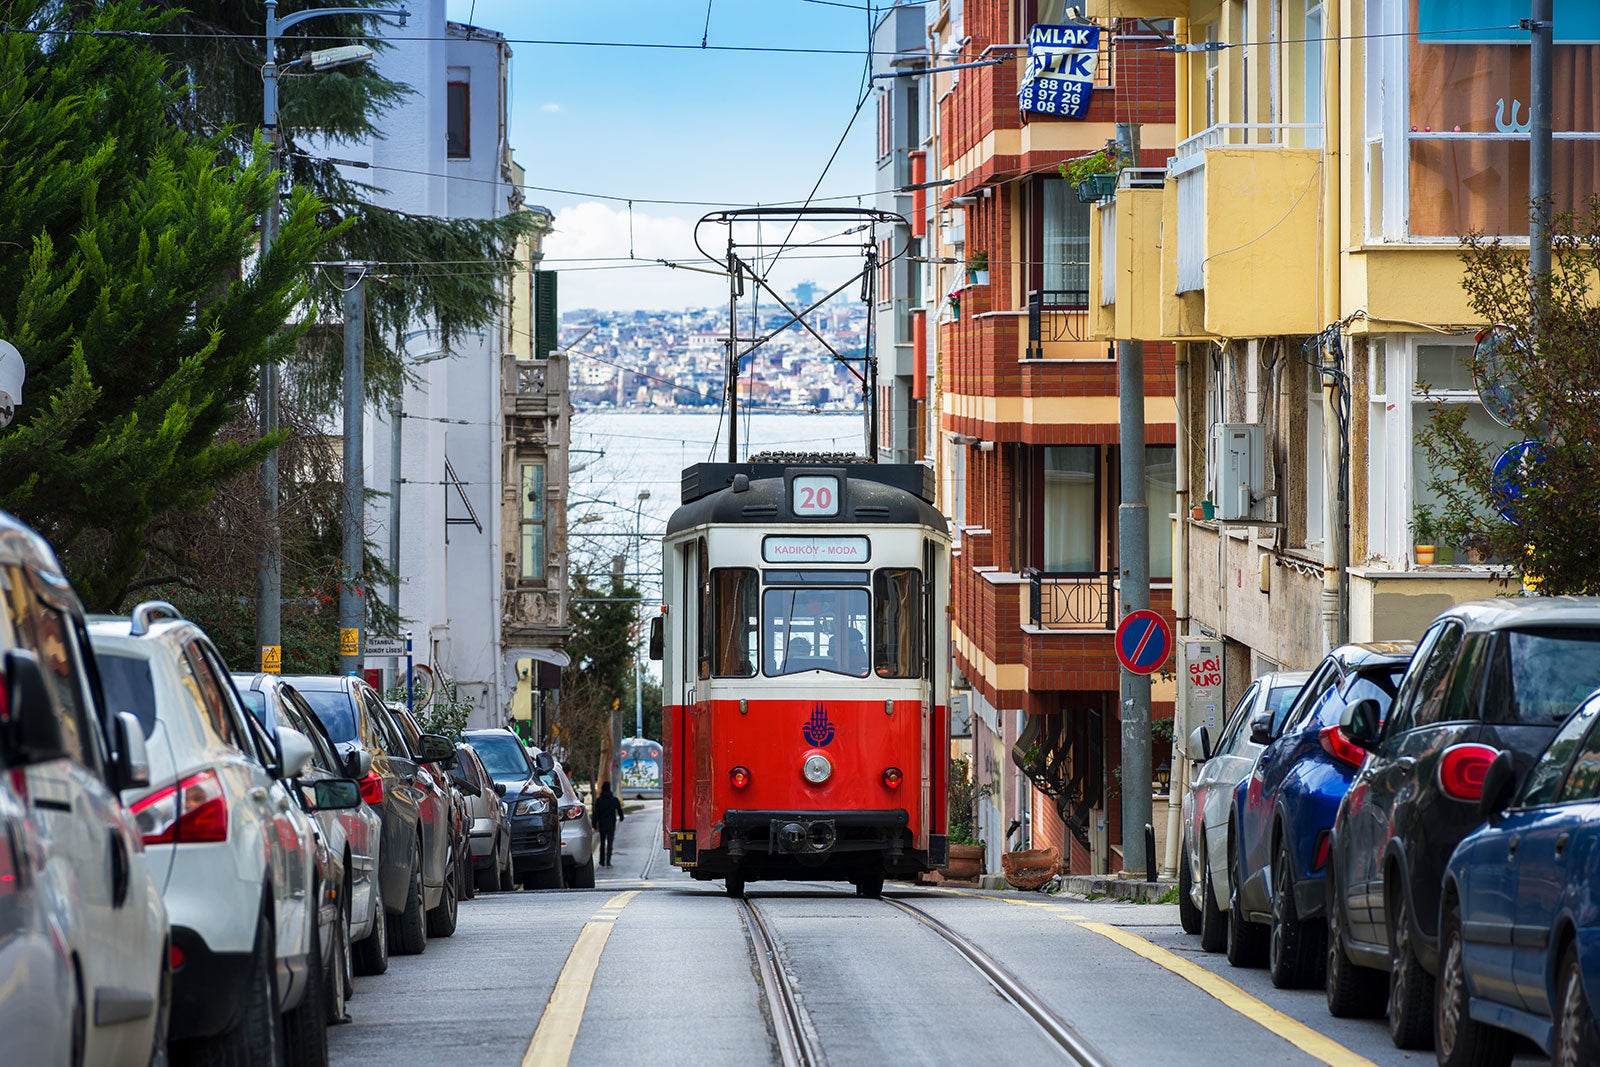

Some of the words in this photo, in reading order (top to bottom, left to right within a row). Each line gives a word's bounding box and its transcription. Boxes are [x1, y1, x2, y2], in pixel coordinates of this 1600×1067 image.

[1033, 52, 1092, 77] ALIK
[1039, 79, 1058, 90] 88
[1062, 81, 1082, 93] 04
[1038, 90, 1058, 101] 97
[1061, 91, 1081, 104] 26
[1036, 100, 1056, 113] 08
[1060, 104, 1080, 116] 37
[800, 487, 832, 509] 20
[774, 544, 819, 555] KADIKÖY
[827, 546, 858, 555] MODA
[364, 646, 385, 654] ADIKÖY
